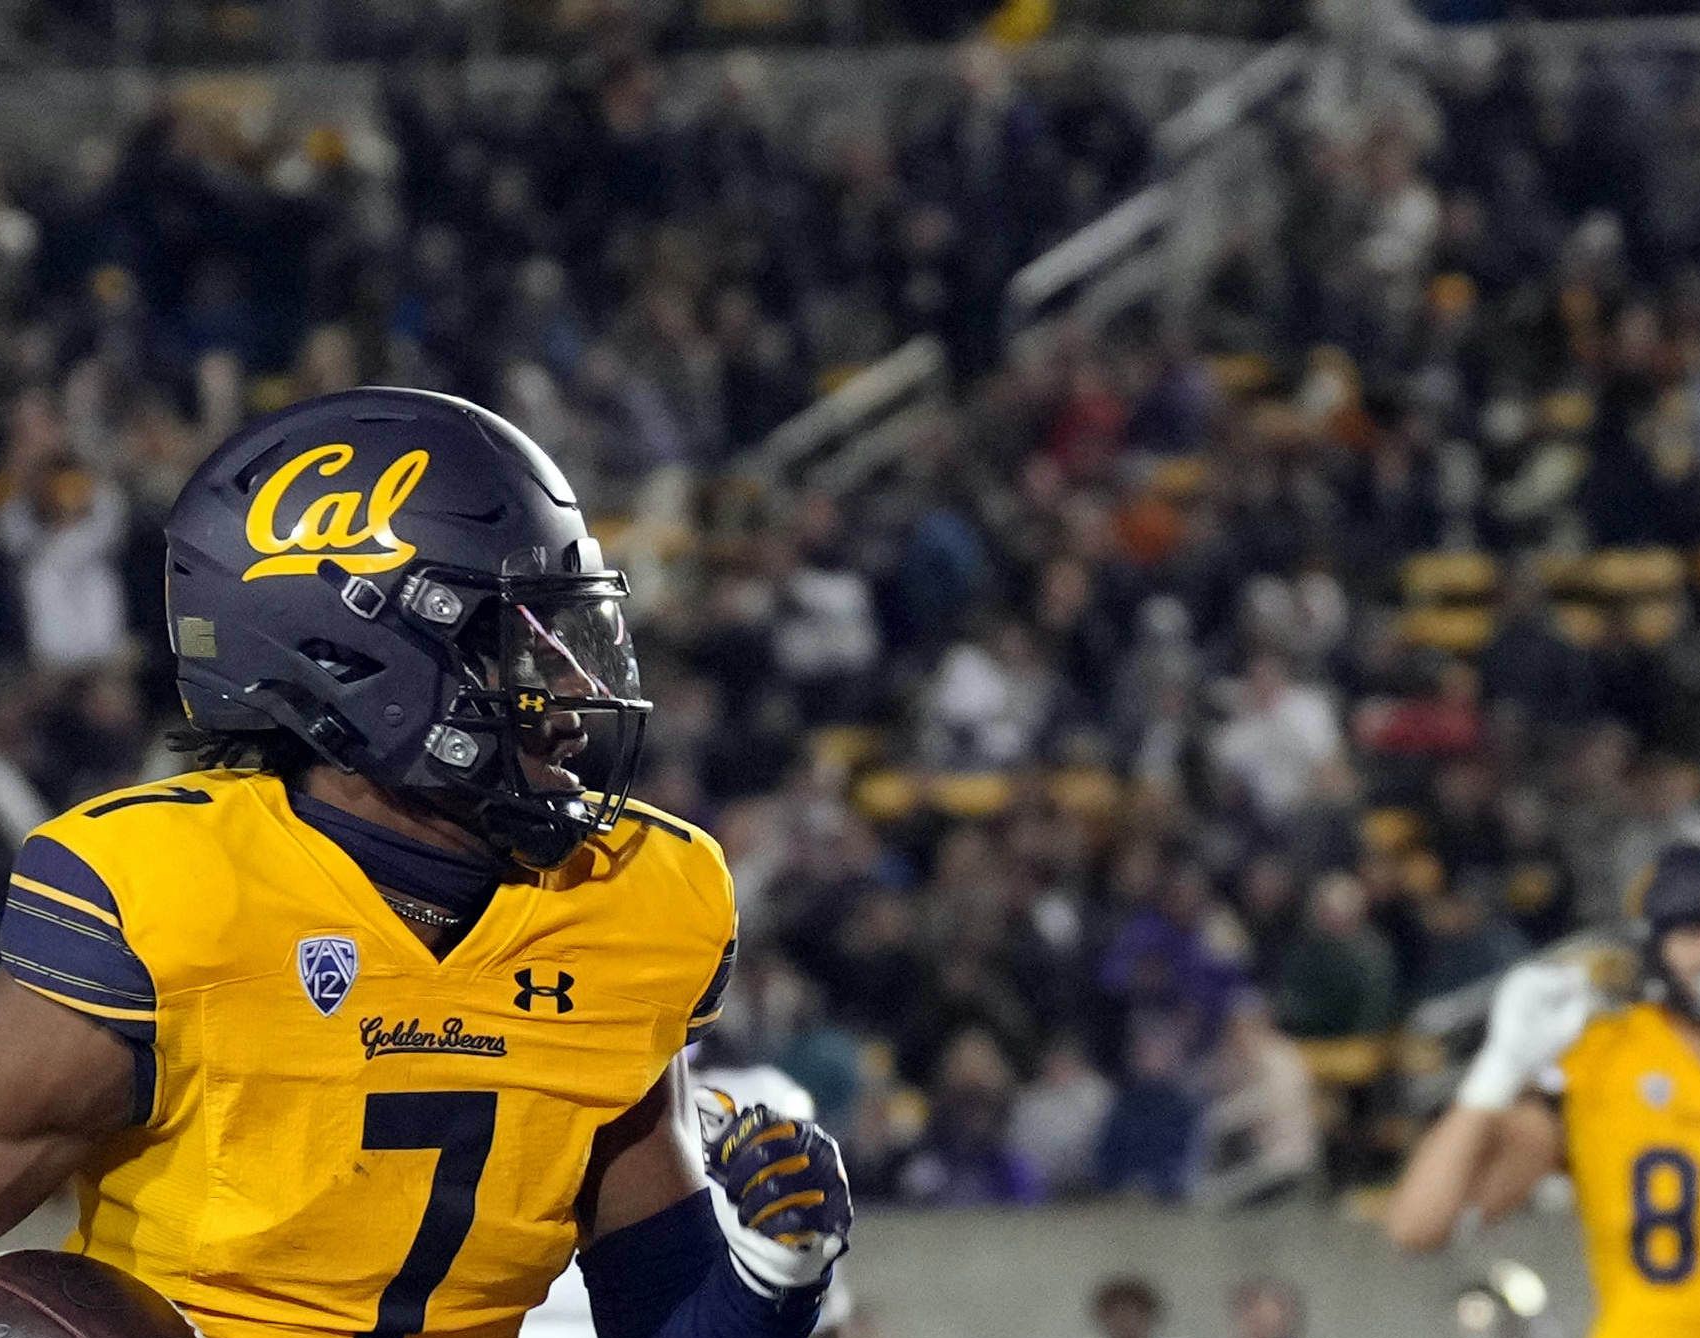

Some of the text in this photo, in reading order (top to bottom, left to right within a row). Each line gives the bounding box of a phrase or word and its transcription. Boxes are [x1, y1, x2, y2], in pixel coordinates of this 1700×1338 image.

[242, 443, 430, 582] Cal
[313, 970, 341, 999] 12
[359, 1016, 507, 1060] Golden Bears
